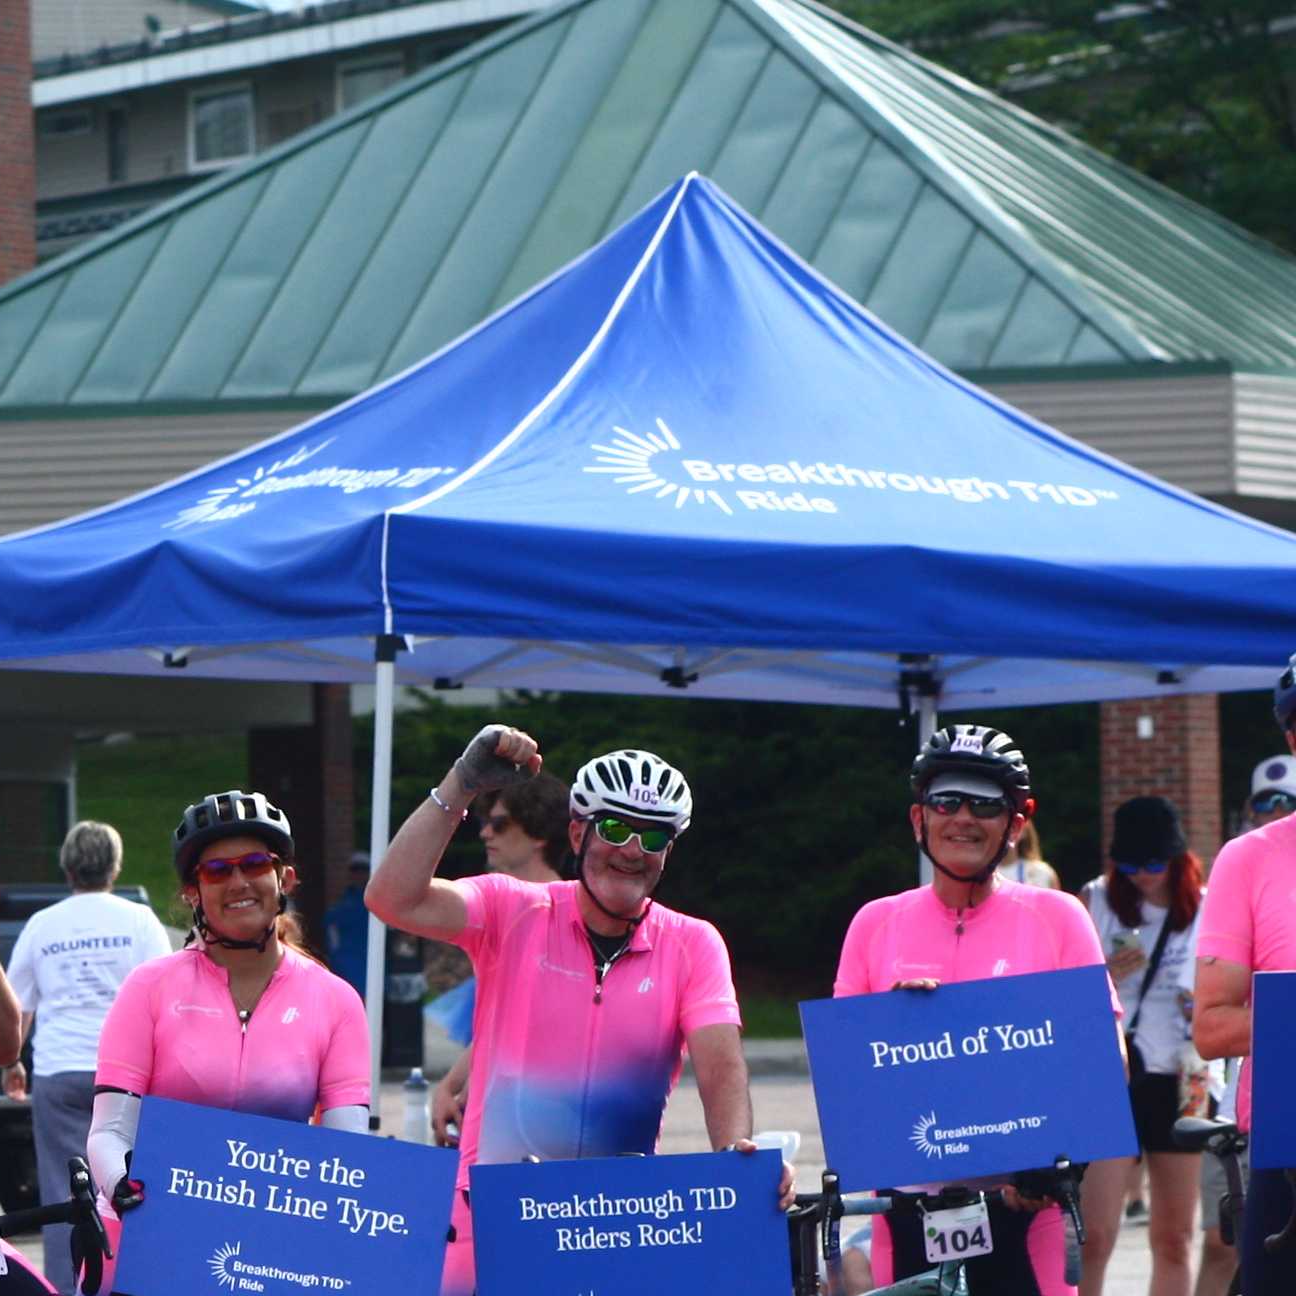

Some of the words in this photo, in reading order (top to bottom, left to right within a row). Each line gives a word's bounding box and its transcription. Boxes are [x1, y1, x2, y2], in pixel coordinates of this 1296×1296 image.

[682, 460, 1009, 502] Breakthrough
[736, 491, 837, 513] Ride
[41, 936, 133, 956] VOLUNTEER
[870, 1032, 954, 1067] Proud
[962, 1027, 988, 1055] of
[994, 1020, 1053, 1050] You!
[934, 1120, 1017, 1140] Breakthrough
[945, 1142, 969, 1154] Ride
[227, 1140, 310, 1178] You're
[320, 1158, 365, 1187] the
[168, 1168, 255, 1207] Finish
[265, 1185, 327, 1219] Line
[337, 1197, 408, 1236] Type.
[520, 1190, 683, 1220] Breakthrough
[690, 1187, 736, 1210] T1D
[557, 1227, 631, 1250] Riders
[638, 1221, 702, 1246] Rock!
[934, 1226, 987, 1254] 104
[233, 1261, 319, 1286] Breakthrough
[239, 1278, 264, 1291] Ride
